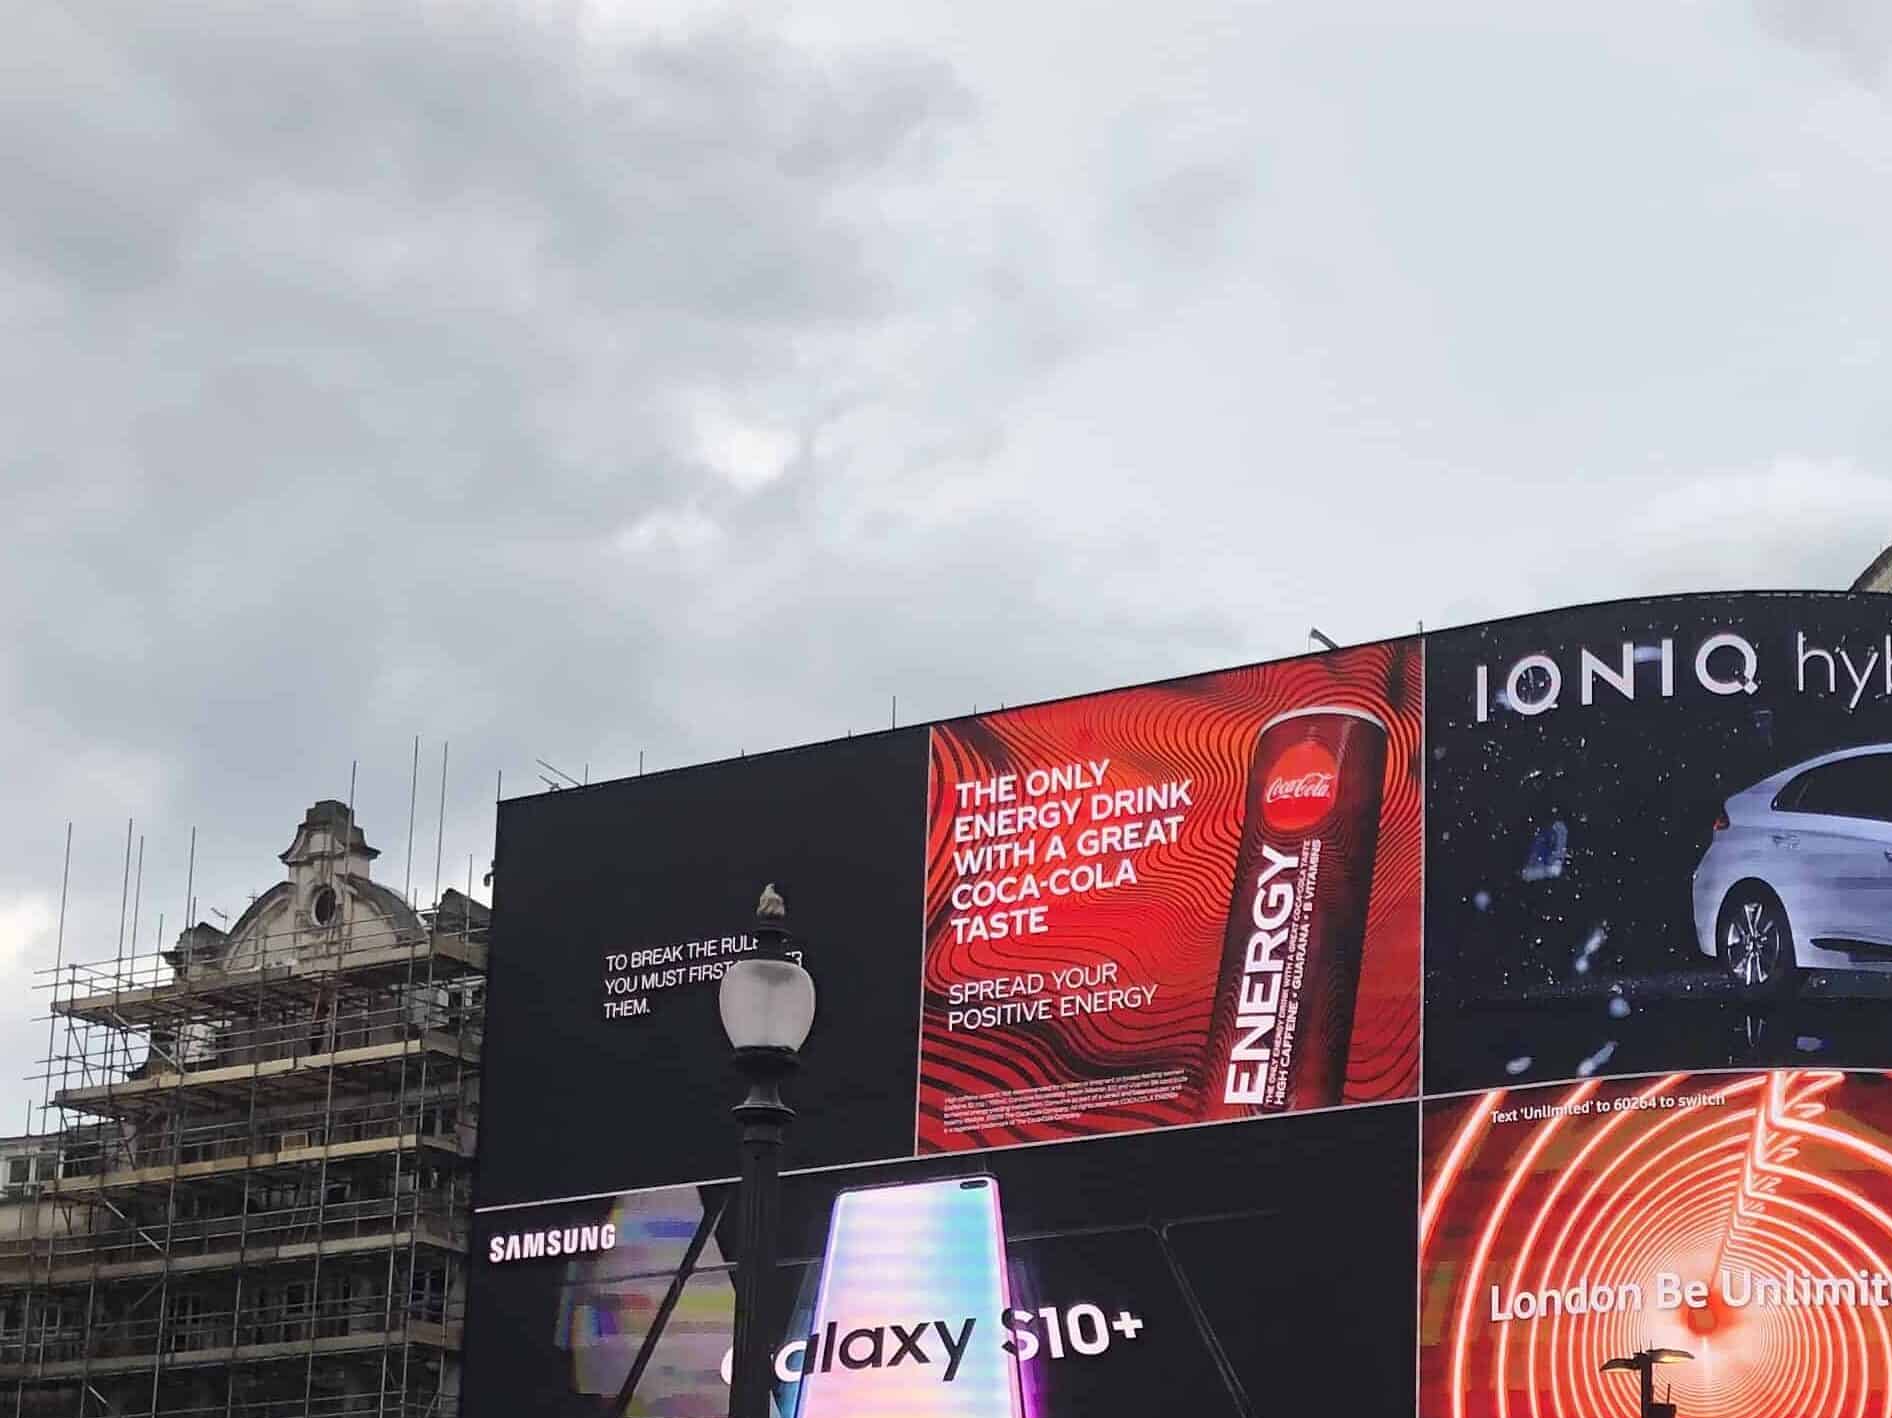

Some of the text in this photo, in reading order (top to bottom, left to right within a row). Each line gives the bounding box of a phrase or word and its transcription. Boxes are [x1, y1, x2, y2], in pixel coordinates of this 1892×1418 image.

[1476, 632, 1758, 722] IONIQ
[955, 758, 1110, 809] THE ONLY
[1265, 772, 1335, 803] Coca-Cola
[954, 779, 1193, 843] ENERGY DRINK
[952, 815, 1185, 876] WITH A GREAT
[1304, 839, 1321, 899] VITAMINS
[951, 859, 1138, 911] COCA-COLA
[950, 905, 1049, 945] TASTE
[604, 960, 734, 995] YOU MUST FIRST
[605, 954, 628, 972] TO
[631, 946, 684, 968] BREAK
[687, 939, 718, 959] THE
[1223, 844, 1300, 1105] ENERGY
[1282, 962, 1293, 987] WITH
[1291, 924, 1311, 989] GUARANA
[948, 961, 1118, 1005] SPREAD YOUR
[948, 983, 1159, 1032] POSITIVE ENERGY
[603, 998, 651, 1019] THEM.
[1279, 1001, 1299, 1067] CAFFEINE
[1274, 1070, 1288, 1105] HIGH
[1490, 1109, 1518, 1124] Text
[1596, 1100, 1611, 1113] to
[1613, 1096, 1657, 1111] 60264
[1660, 1095, 1675, 1108] to
[1677, 1092, 1727, 1107] switch
[489, 1223, 616, 1263] SAMSUNG
[1490, 1279, 1642, 1321] London
[1656, 1272, 1709, 1309] Be
[720, 1303, 1144, 1385] alaxy S10+
